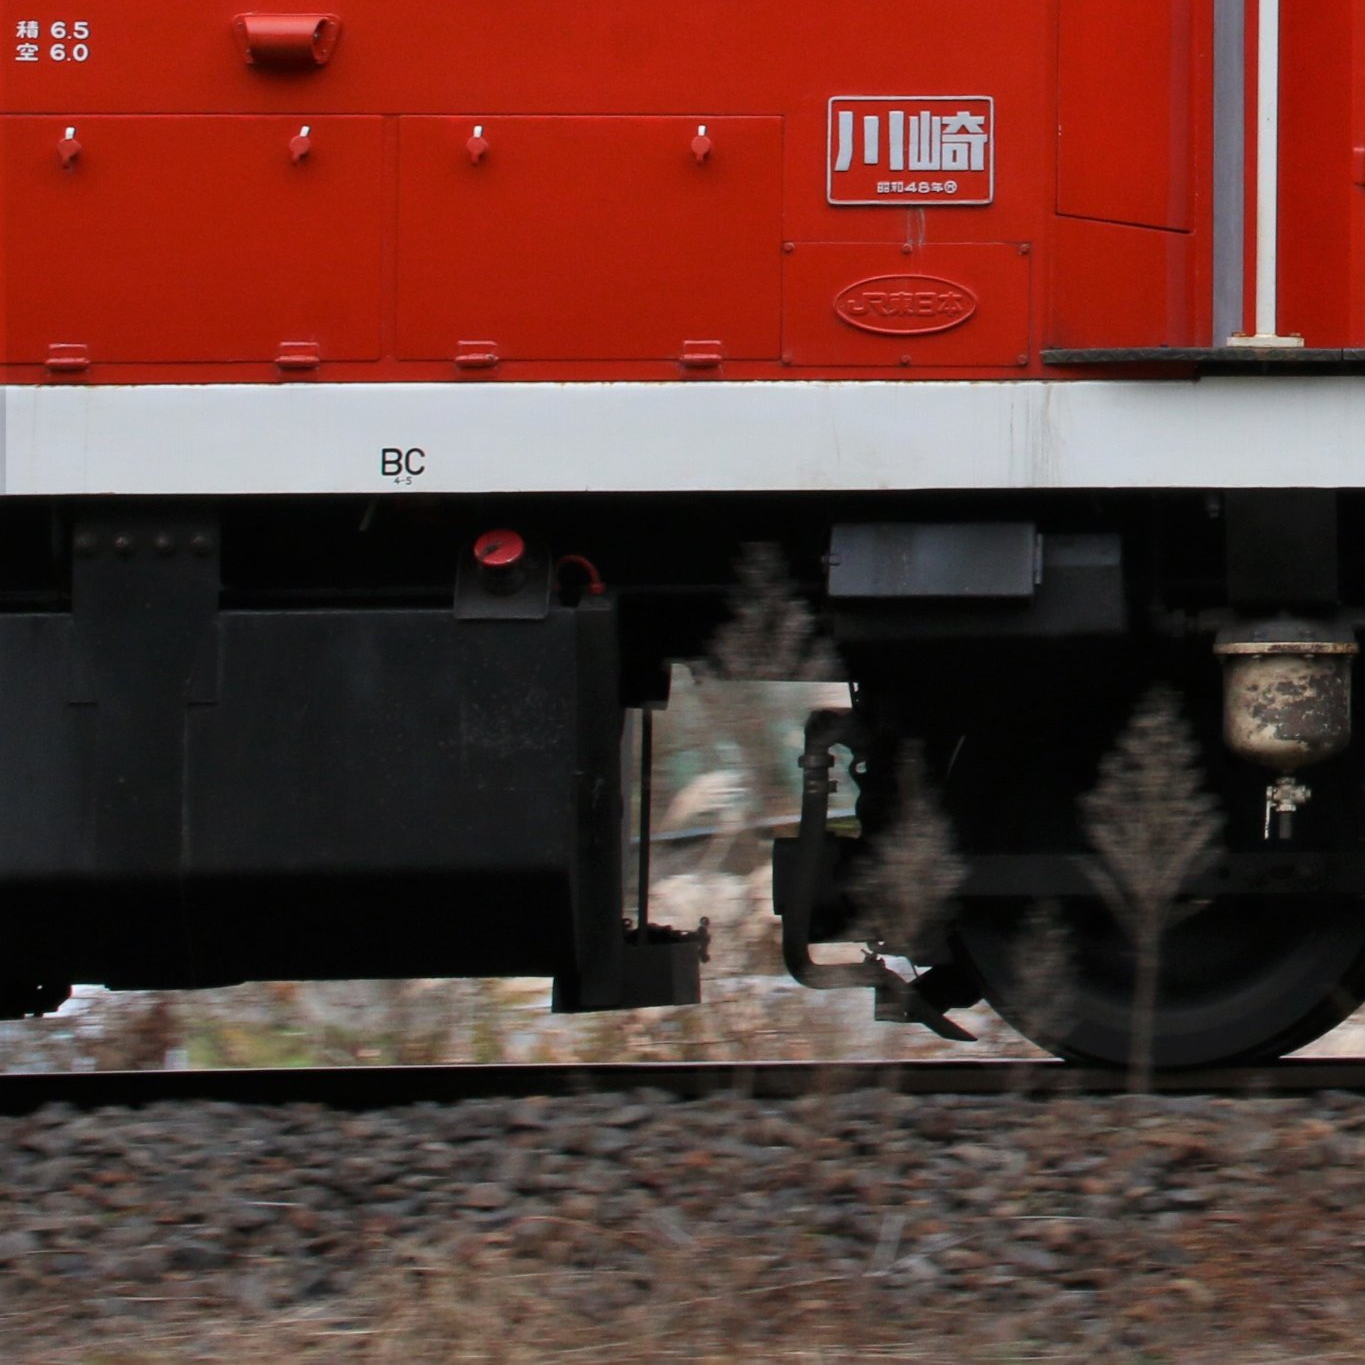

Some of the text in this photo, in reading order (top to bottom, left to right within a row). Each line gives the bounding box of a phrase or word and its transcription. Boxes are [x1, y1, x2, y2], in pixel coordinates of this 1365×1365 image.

[50, 20, 90, 40] 6.5
[14, 42, 90, 63] 空 6.0
[833, 110, 988, 172] 川崎
[381, 447, 426, 477] BC
